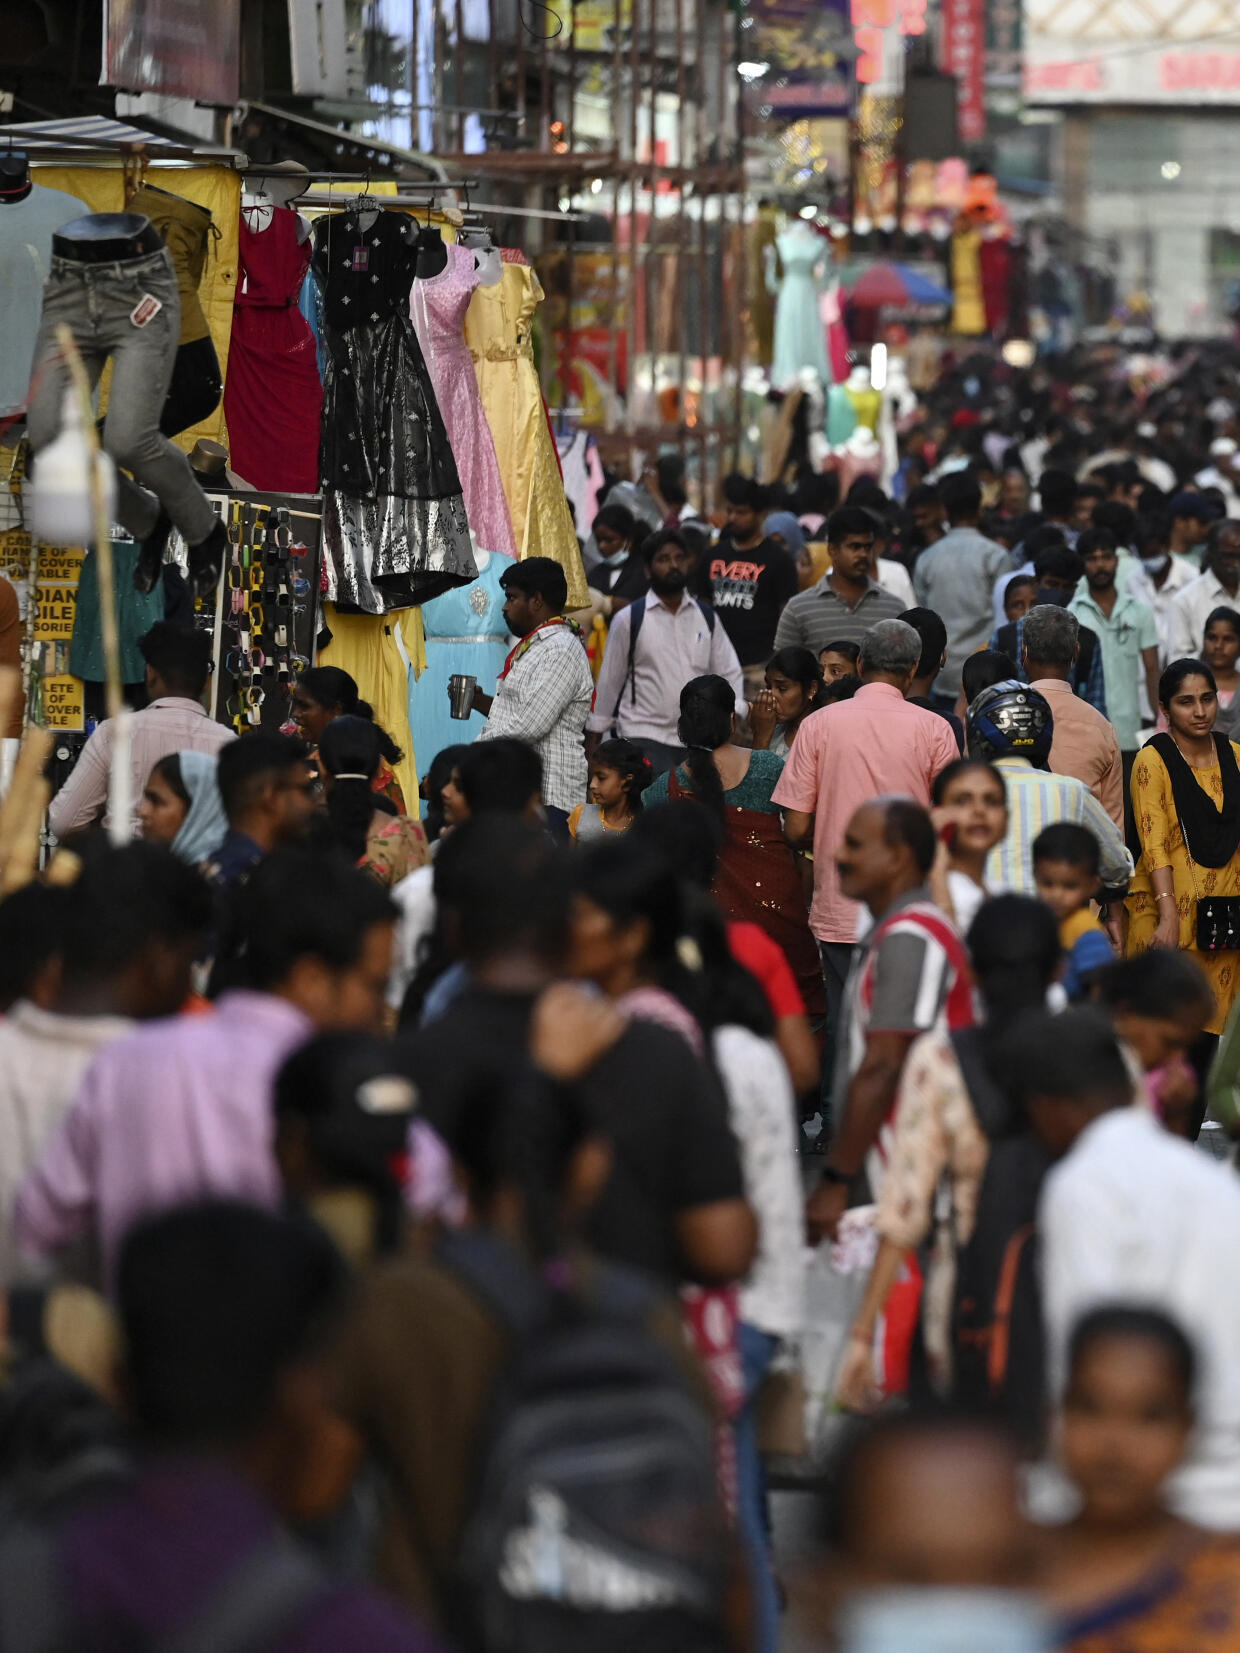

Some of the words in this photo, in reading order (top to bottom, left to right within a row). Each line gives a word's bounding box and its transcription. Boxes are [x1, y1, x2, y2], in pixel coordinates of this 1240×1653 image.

[51, 547, 68, 557] OF
[709, 559, 766, 582] EVERY
[34, 622, 73, 632] SORIE
[49, 694, 65, 704] OF
[47, 705, 81, 714] OVER
